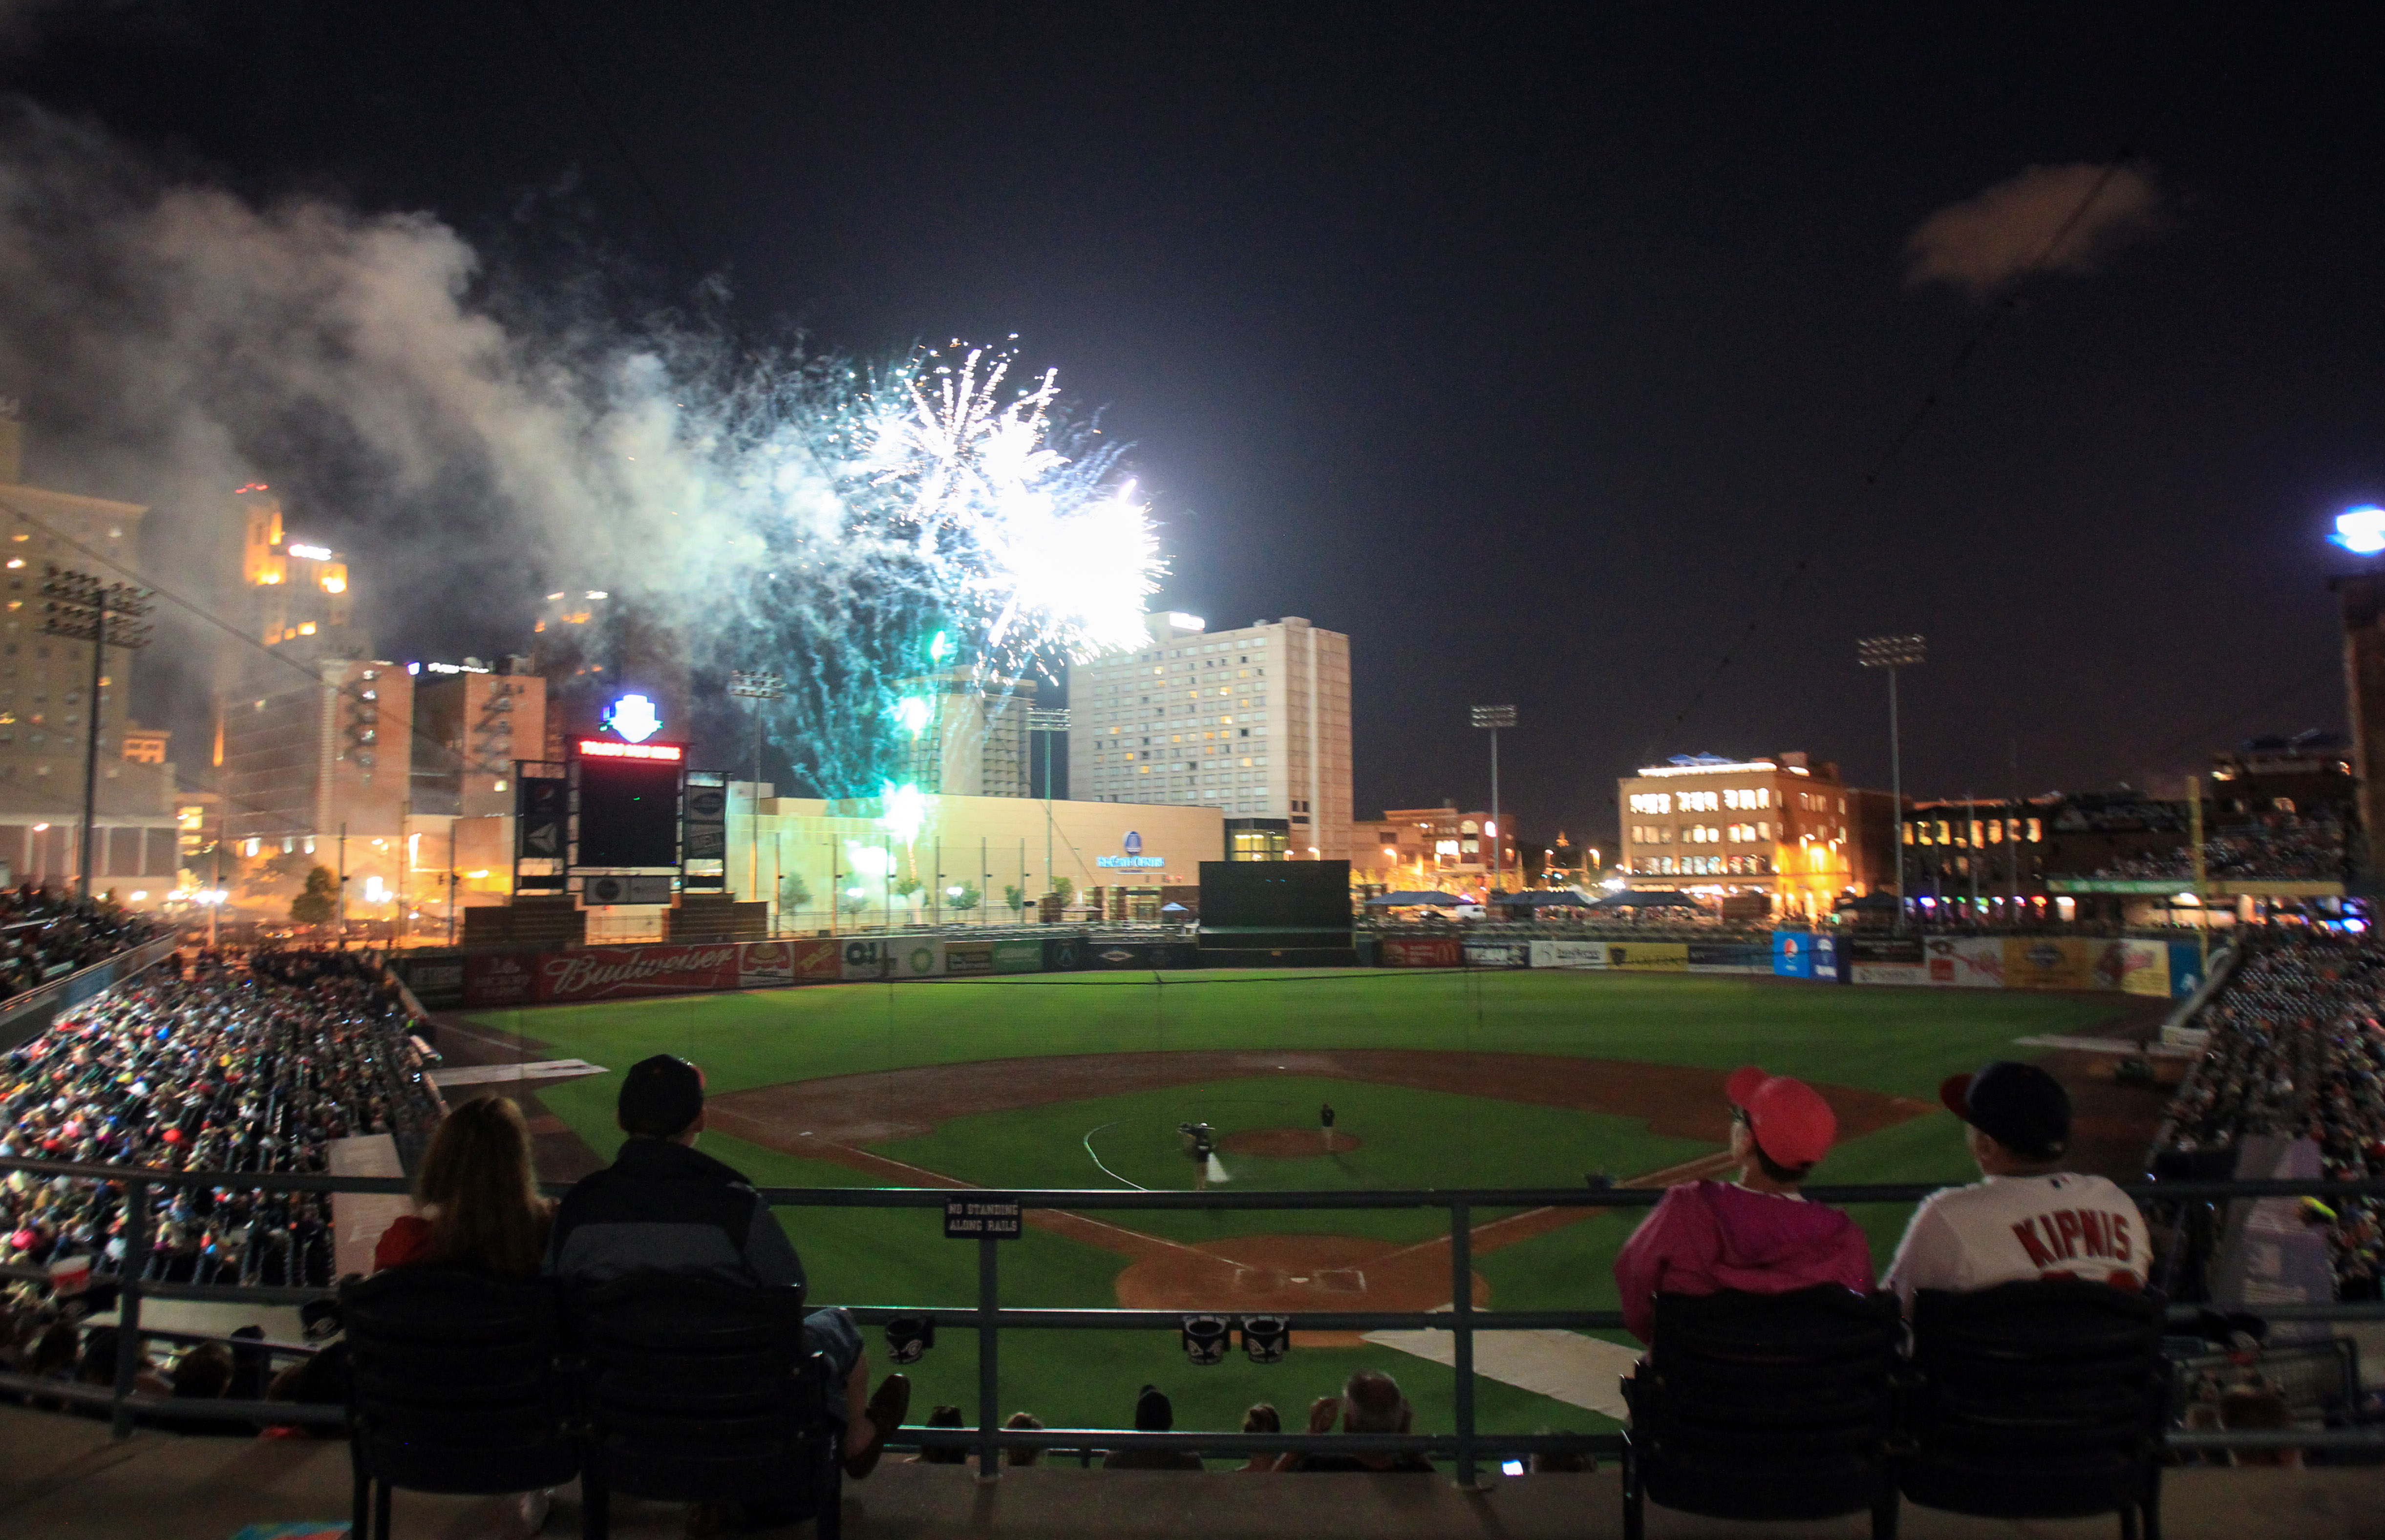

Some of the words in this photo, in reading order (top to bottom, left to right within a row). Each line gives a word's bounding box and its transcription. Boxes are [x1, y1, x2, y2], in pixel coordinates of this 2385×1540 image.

[542, 944, 733, 994] Budweiser
[947, 1203, 963, 1215] NO
[966, 1203, 1019, 1216] STANDING
[948, 1219, 983, 1231] ALONG
[986, 1220, 1018, 1232] RAILS
[2011, 1208, 2132, 1268] KIPNIS
